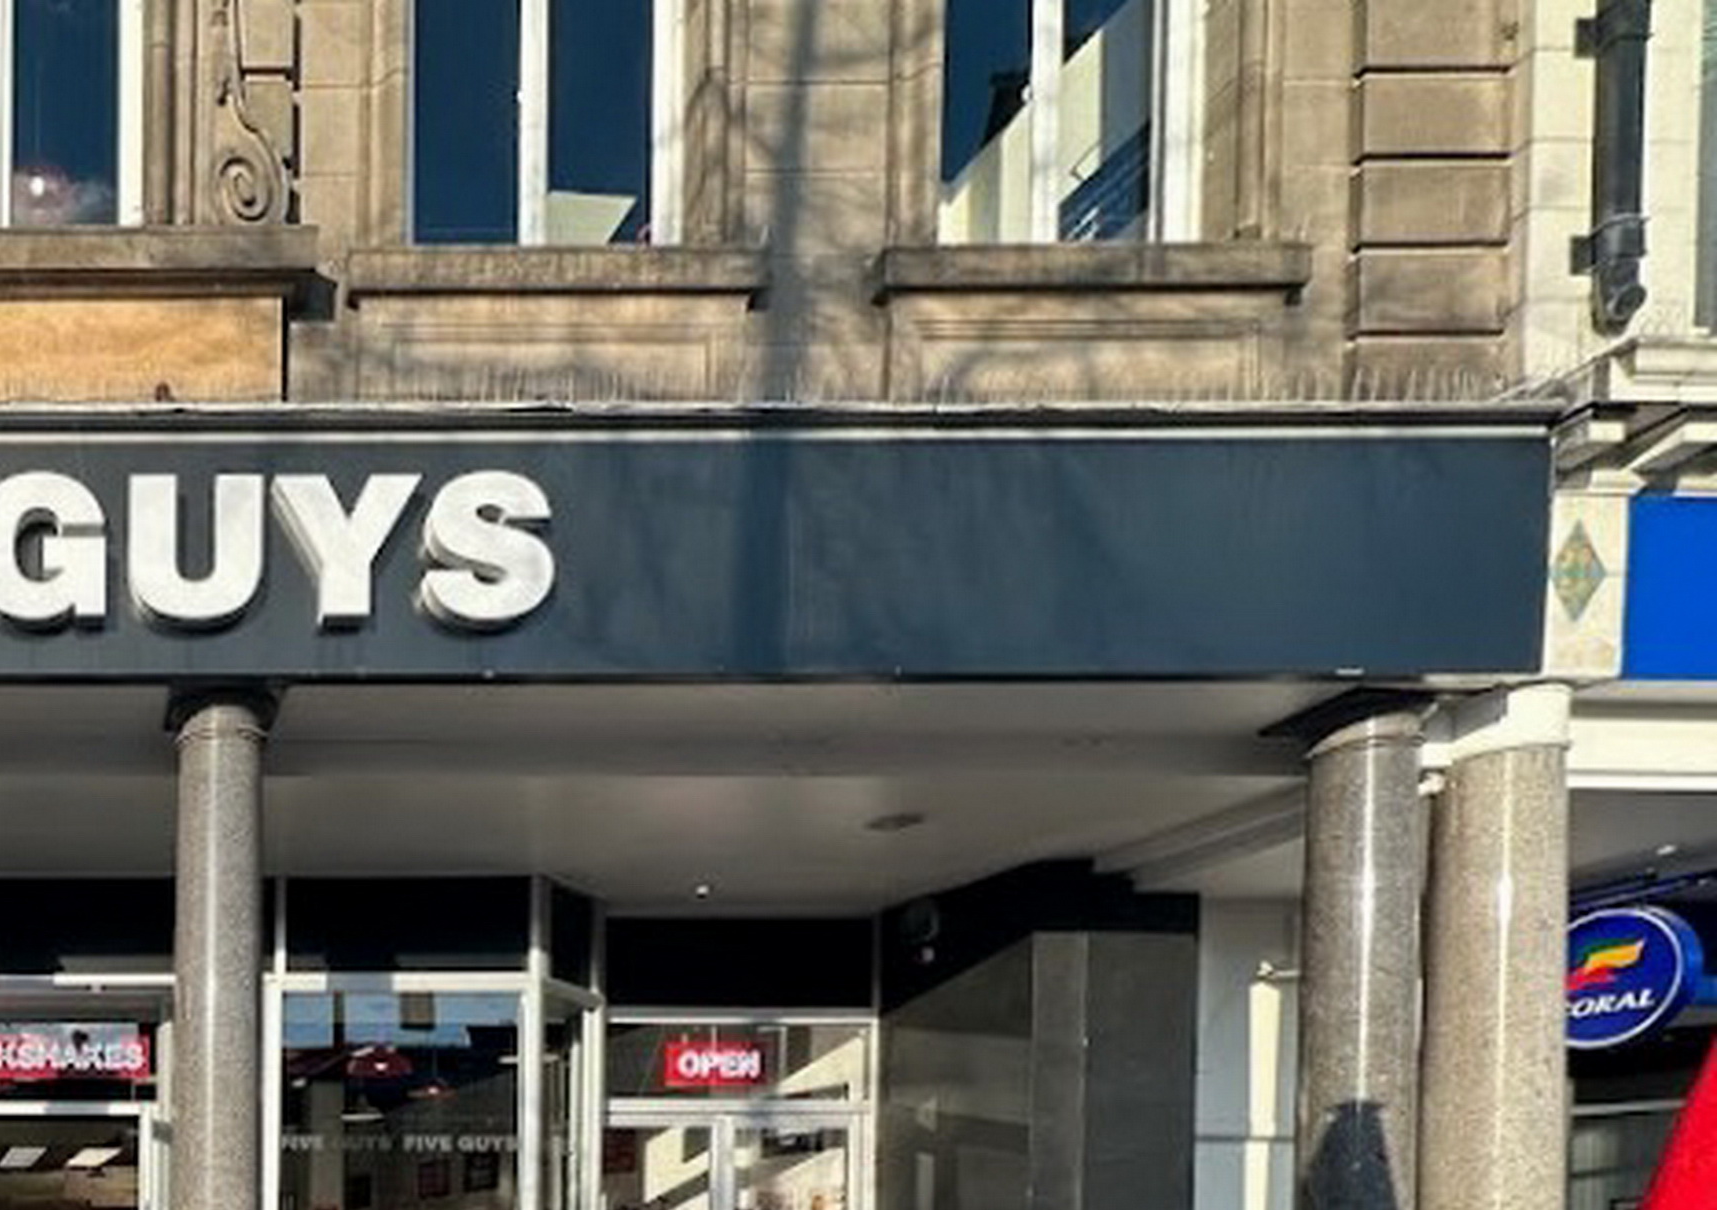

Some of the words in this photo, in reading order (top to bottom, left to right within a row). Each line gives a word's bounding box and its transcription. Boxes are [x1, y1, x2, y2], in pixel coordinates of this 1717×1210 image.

[1566, 988, 1655, 1018] ORAL
[678, 1050, 761, 1078] OPEN
[403, 1135, 452, 1151] FIVE
